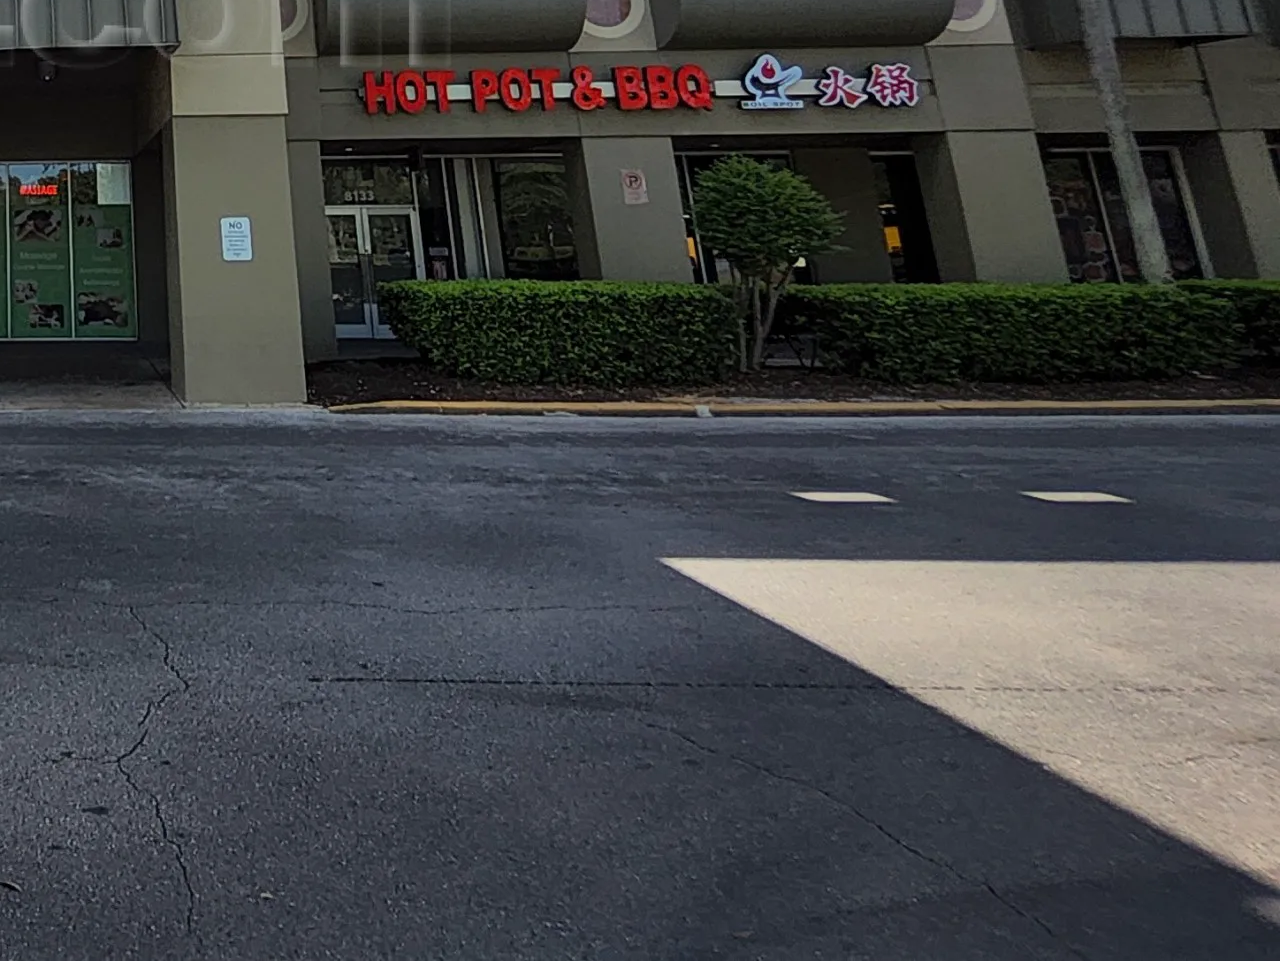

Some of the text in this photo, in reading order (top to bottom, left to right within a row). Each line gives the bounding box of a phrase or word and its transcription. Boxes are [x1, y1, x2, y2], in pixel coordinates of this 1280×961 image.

[363, 64, 713, 114] HOT POT & BBQ
[344, 190, 374, 202] 8133
[228, 221, 243, 229] NO
